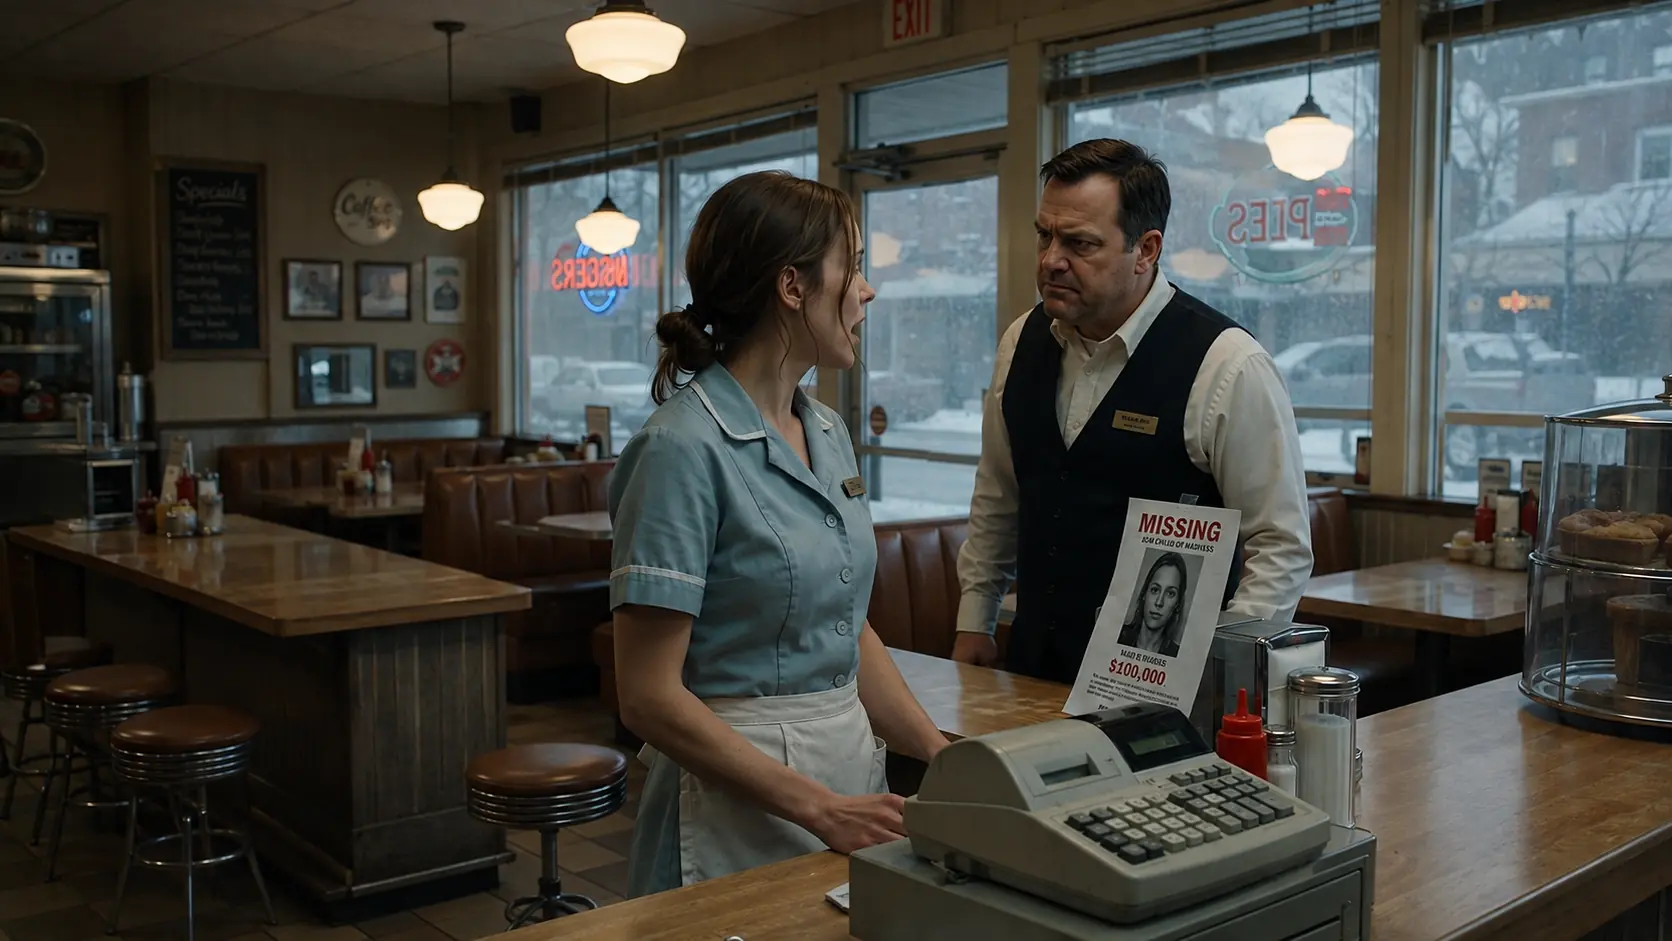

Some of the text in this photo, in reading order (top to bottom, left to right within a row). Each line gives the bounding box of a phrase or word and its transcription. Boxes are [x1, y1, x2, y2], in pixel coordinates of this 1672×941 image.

[176, 176, 248, 205] Specials
[1138, 512, 1222, 542] MISSING
[1108, 658, 1166, 686] $100,000
